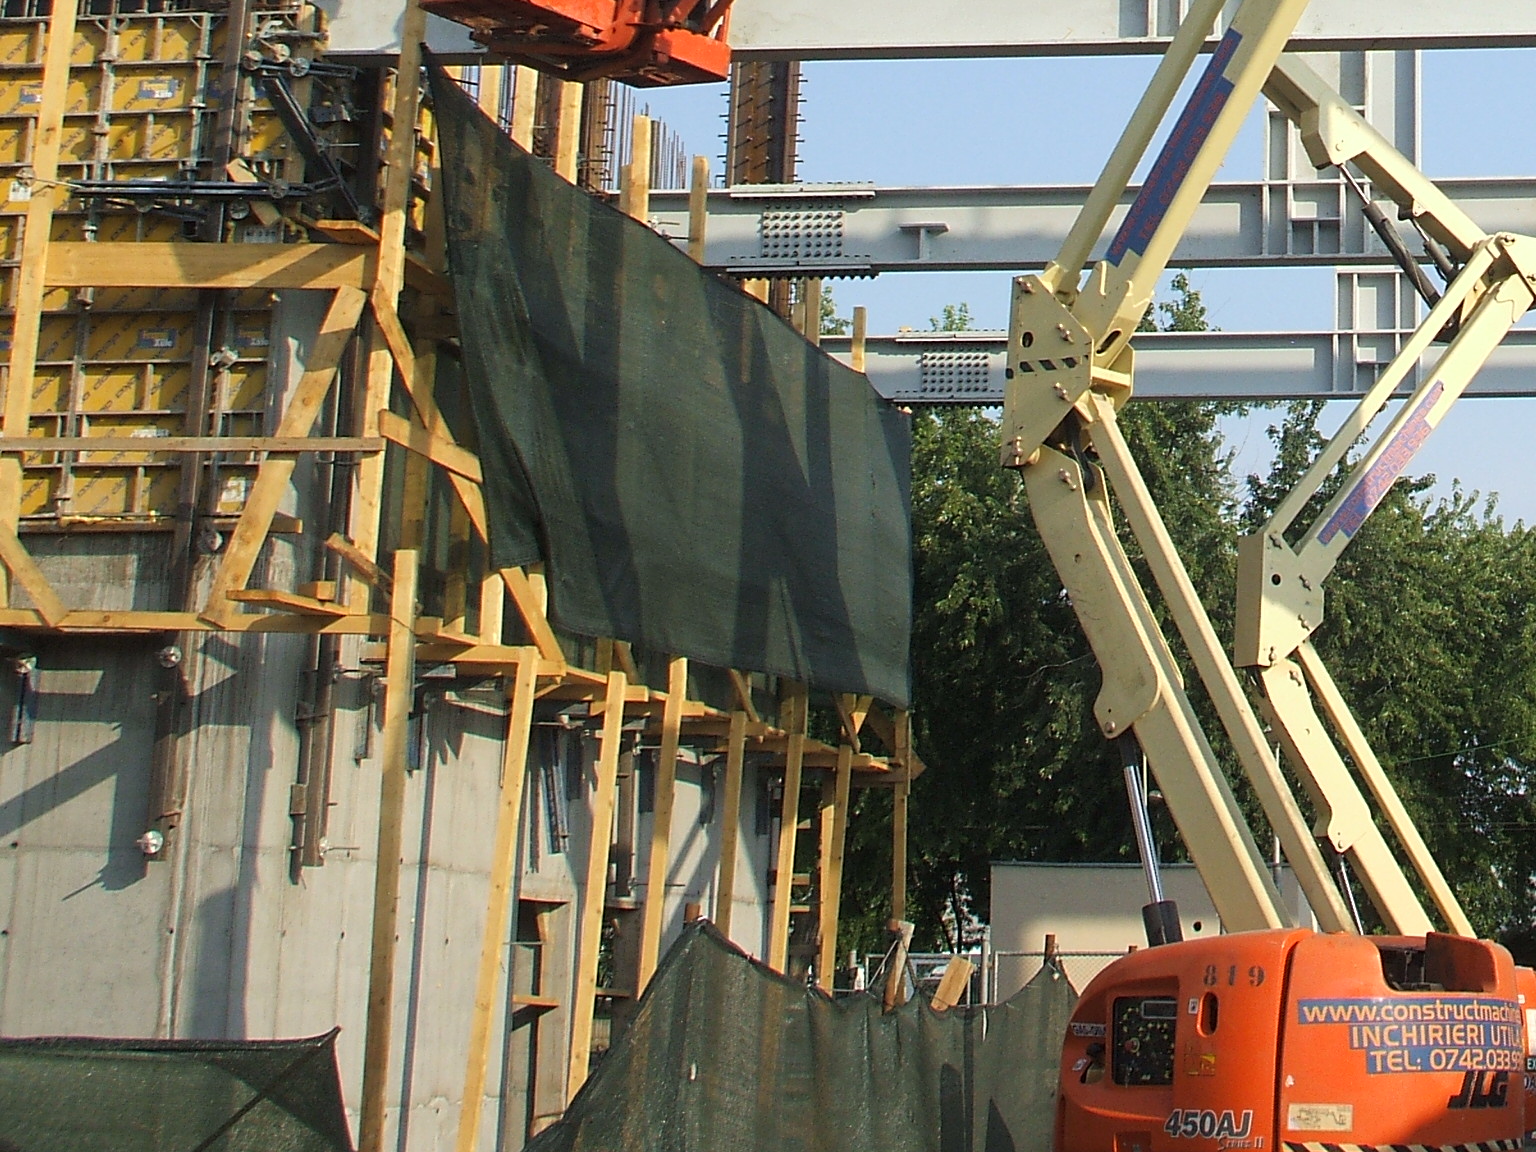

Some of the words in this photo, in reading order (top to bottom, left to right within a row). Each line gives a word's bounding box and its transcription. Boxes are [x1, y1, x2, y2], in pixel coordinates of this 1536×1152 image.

[1351, 1024, 1485, 1048] INCHIRIERI
[1369, 1050, 1422, 1072] TEL:
[1447, 1070, 1509, 1109] JLG
[1164, 1109, 1253, 1139] 450AJ
